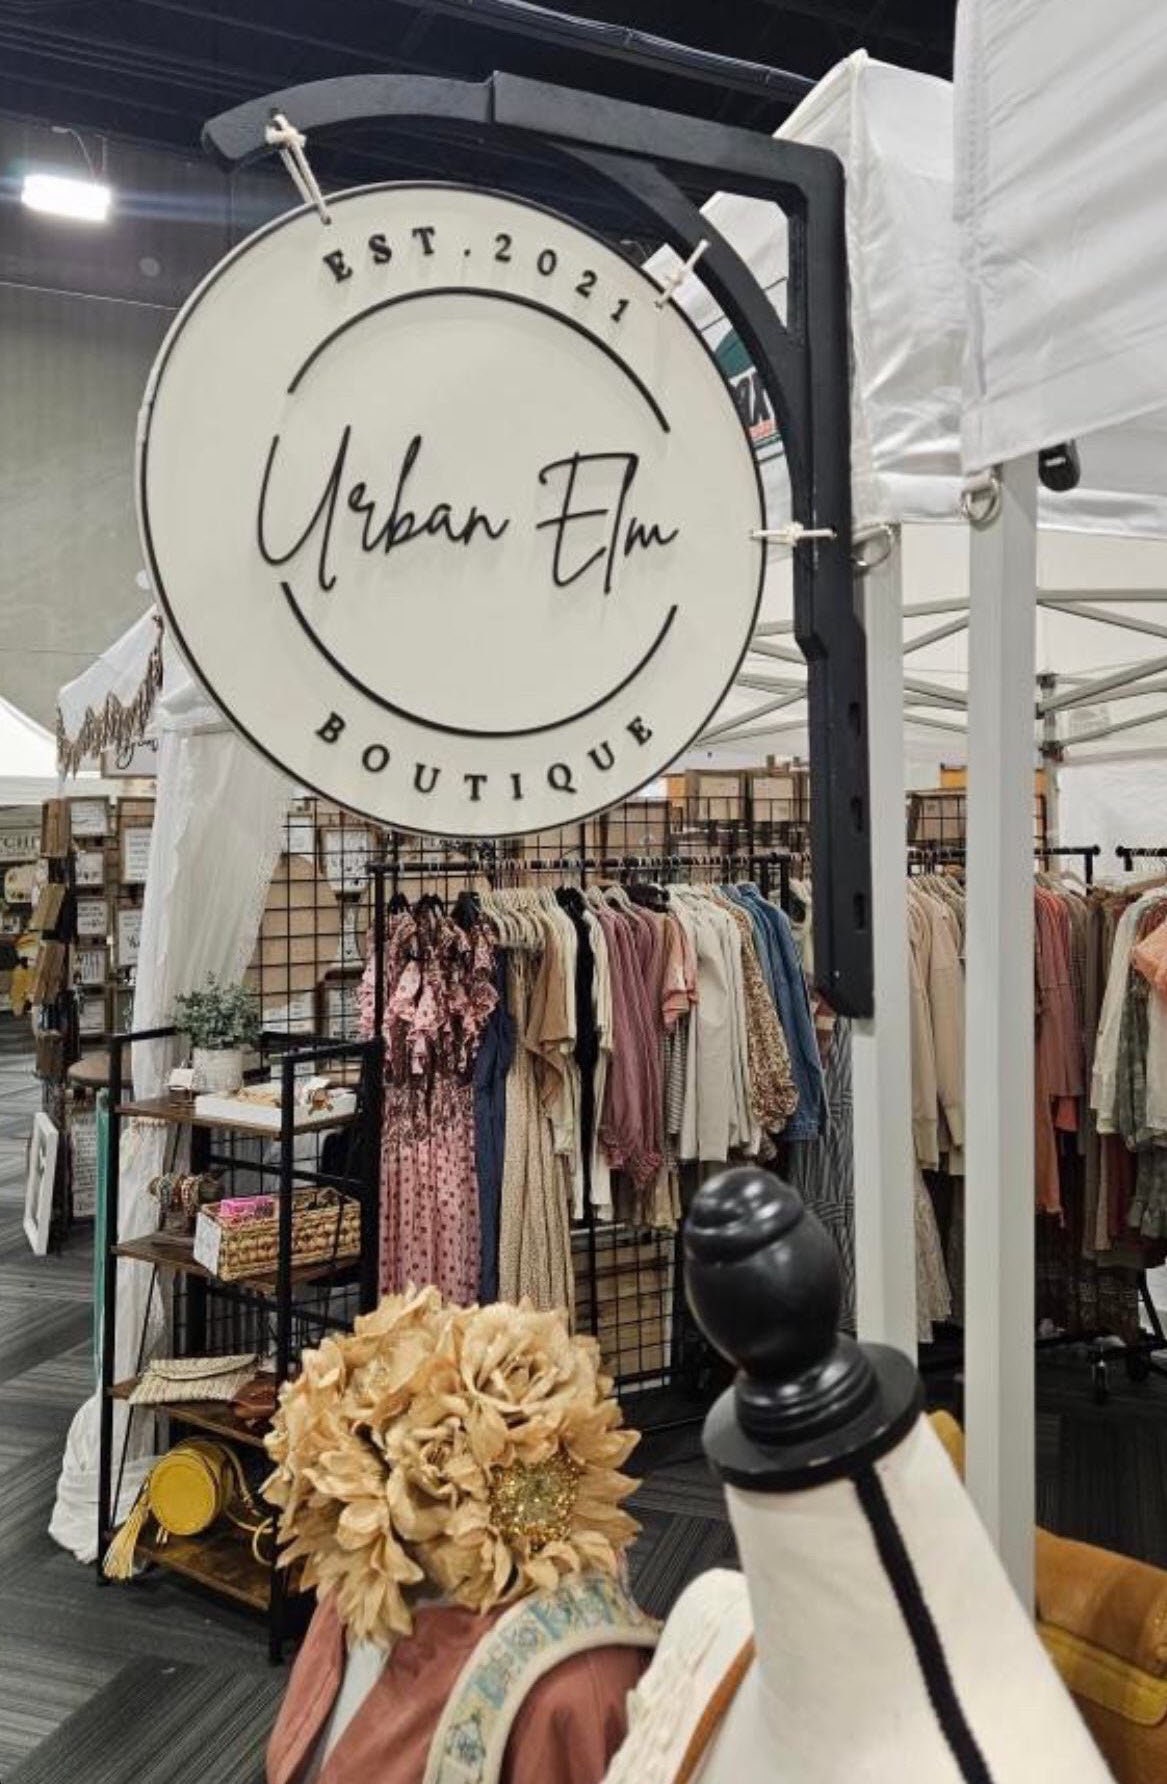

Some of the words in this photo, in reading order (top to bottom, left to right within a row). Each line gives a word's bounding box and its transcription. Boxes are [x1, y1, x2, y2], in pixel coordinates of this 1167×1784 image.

[257, 425, 510, 593] Urban
[536, 452, 679, 595] Elm
[315, 712, 653, 802] BOUTIQUE
